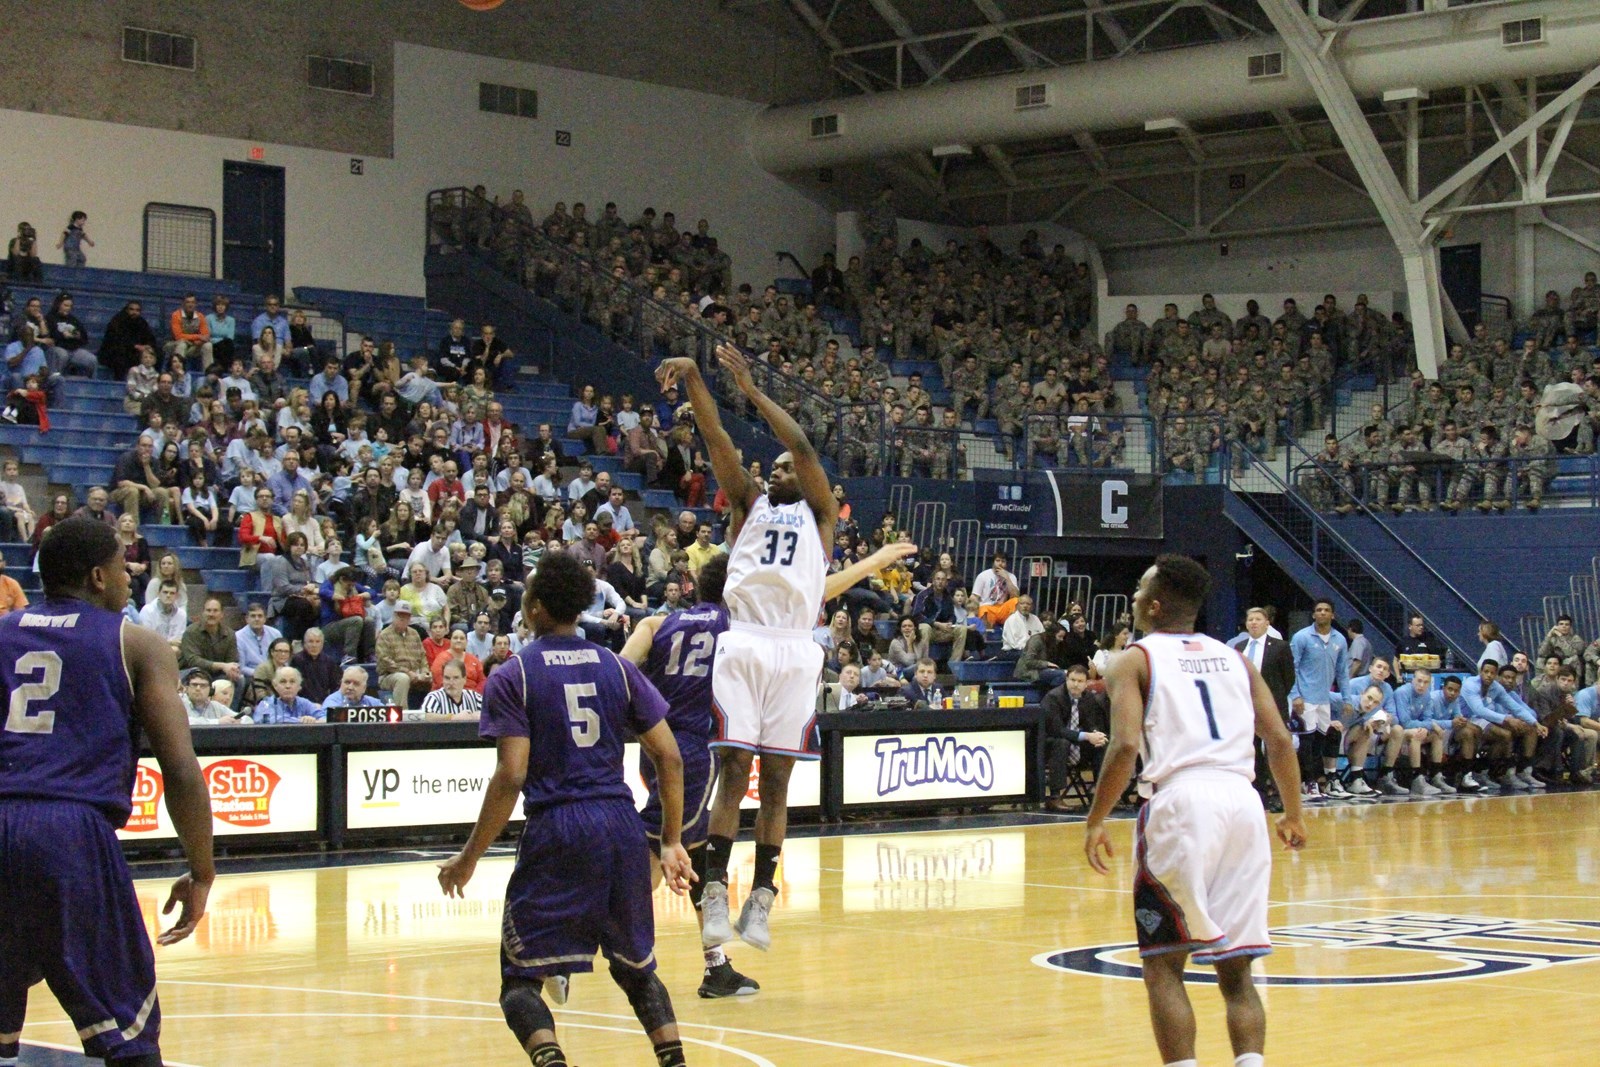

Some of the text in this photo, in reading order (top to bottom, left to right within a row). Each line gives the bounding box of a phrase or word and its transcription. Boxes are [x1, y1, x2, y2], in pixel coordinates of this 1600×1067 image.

[557, 132, 569, 146] 22
[351, 160, 363, 174] 21
[991, 503, 1032, 512] #TheCitadel
[1101, 480, 1128, 524] C
[760, 529, 798, 566] 33
[664, 630, 715, 678] 12
[1178, 657, 1230, 674] BOUTTE
[4, 650, 63, 734] 2
[1194, 679, 1224, 740] 1
[347, 707, 387, 723] POSS
[564, 682, 601, 747] 5
[211, 765, 268, 797] Sub
[363, 767, 400, 800] yp
[412, 775, 442, 794] the
[447, 777, 484, 793] new
[875, 737, 994, 796] TruMoo
